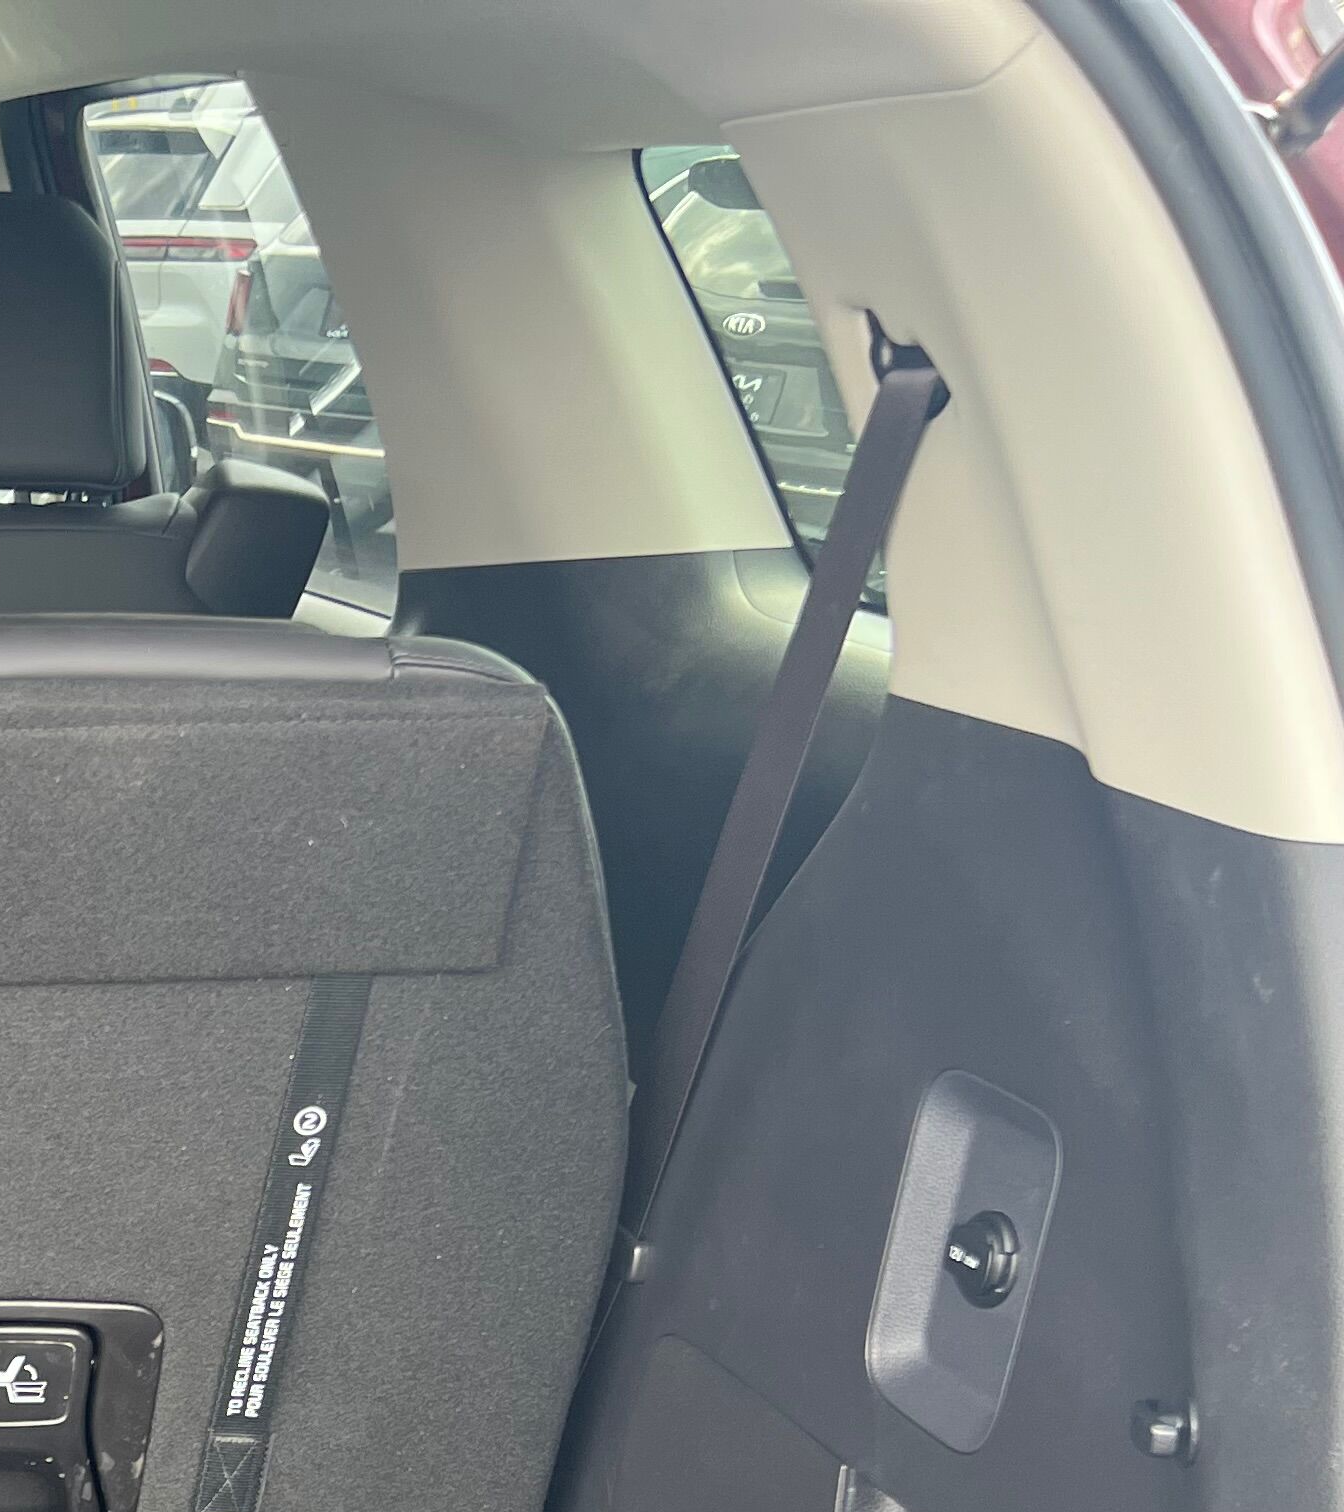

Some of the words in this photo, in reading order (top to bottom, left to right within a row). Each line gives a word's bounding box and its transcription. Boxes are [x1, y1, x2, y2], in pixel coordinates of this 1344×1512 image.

[282, 1182, 312, 1259] SEULEMENT
[258, 1244, 279, 1279] ONLY
[243, 1281, 271, 1345] SEATBACK
[268, 1300, 286, 1317] LE
[253, 1318, 281, 1382] SOULEVER
[231, 1347, 256, 1397] RECLINE
[227, 1399, 243, 1416] TO
[244, 1384, 266, 1418] POUR
